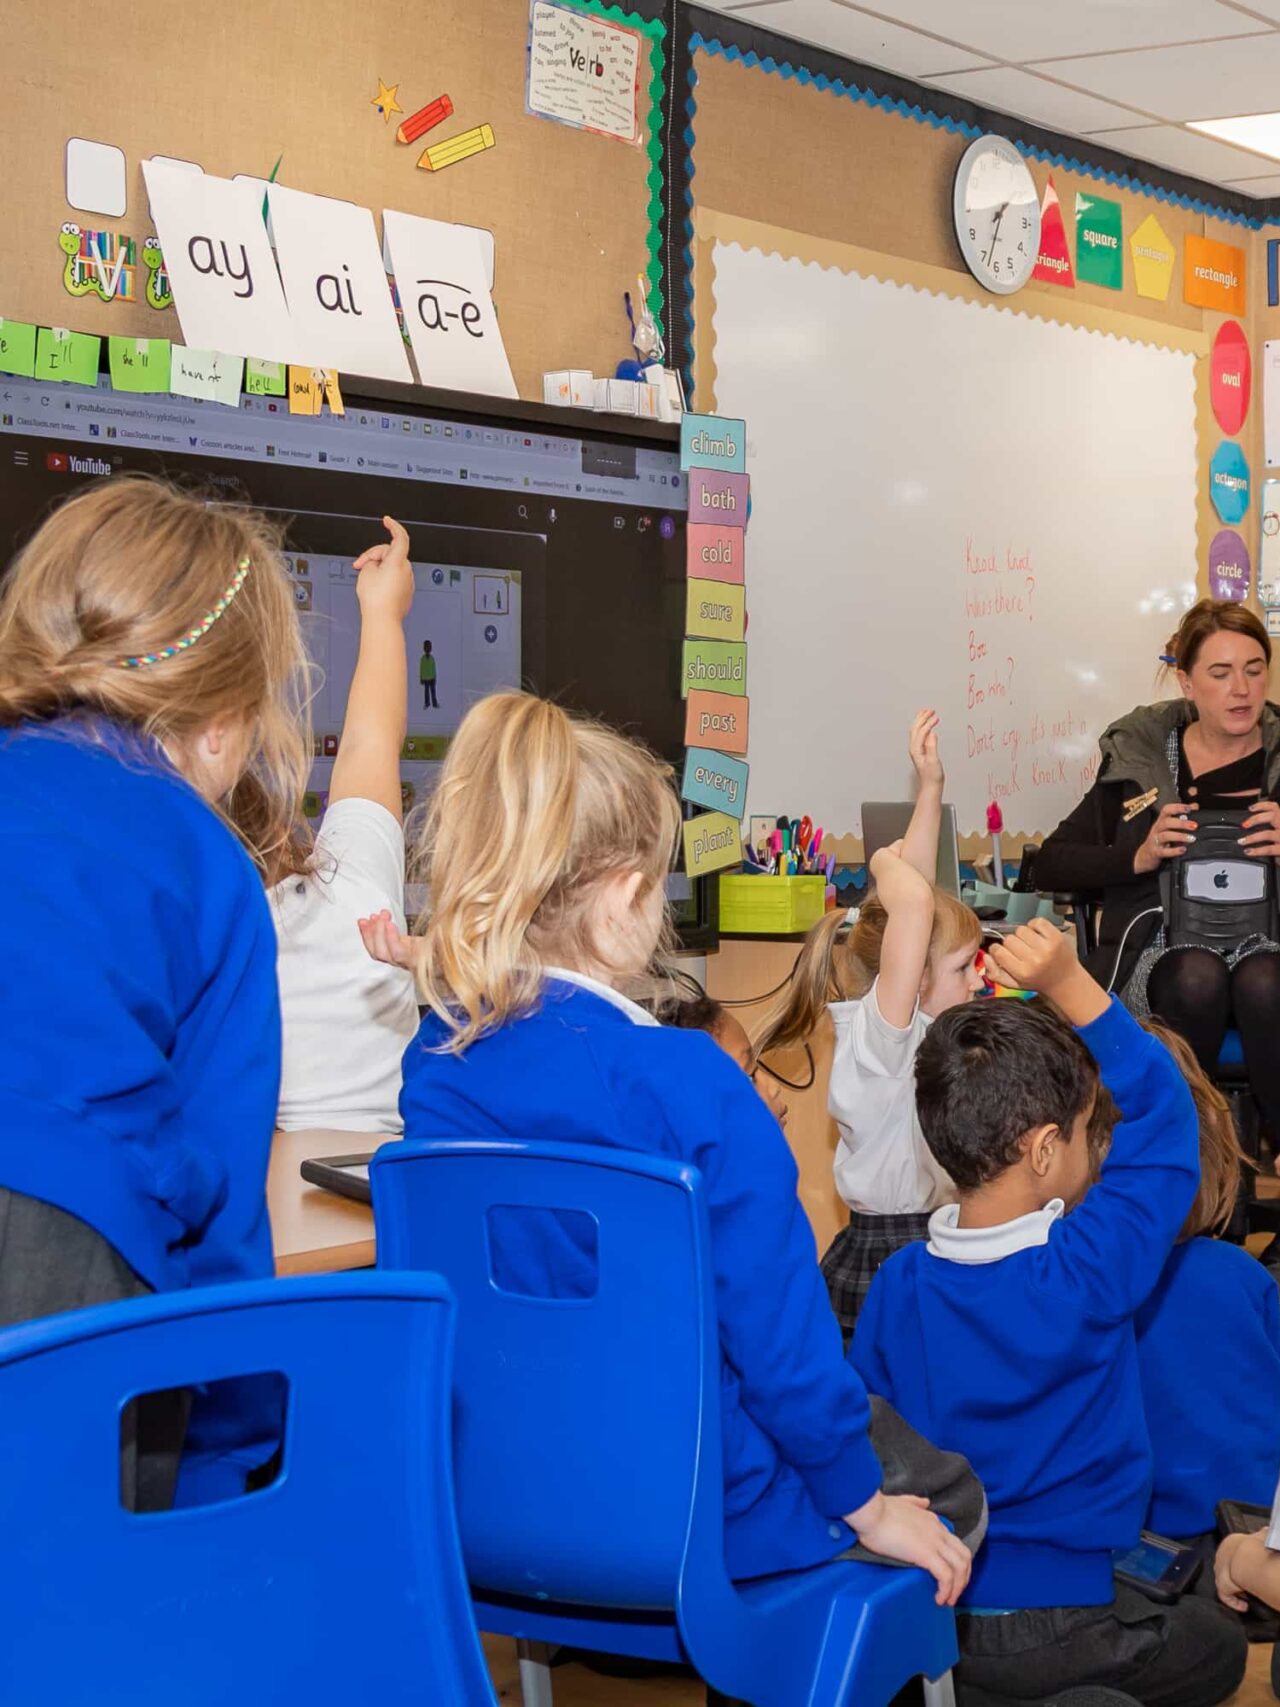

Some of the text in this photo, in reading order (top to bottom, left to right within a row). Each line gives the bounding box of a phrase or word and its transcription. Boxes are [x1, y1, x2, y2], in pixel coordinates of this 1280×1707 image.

[570, 47, 604, 77] Verb
[969, 228, 976, 241] 8
[1083, 228, 1118, 248] square
[980, 250, 987, 263] 7
[1017, 241, 1024, 253] 4
[188, 235, 254, 299] ay
[993, 261, 1000, 274] 6
[1007, 257, 1014, 270] 5
[1195, 265, 1238, 289] rectangle
[316, 264, 362, 316] ai
[1222, 371, 1241, 388] oval
[691, 430, 736, 457] climb
[69, 455, 111, 476] YouTube
[1215, 472, 1247, 491] octagon
[701, 484, 736, 511] bath
[701, 540, 732, 563] cold
[1216, 562, 1243, 579] circle
[700, 601, 732, 622] sure
[687, 656, 742, 680] should
[700, 711, 736, 735] past
[695, 765, 738, 802] every
[693, 826, 734, 863] plant
